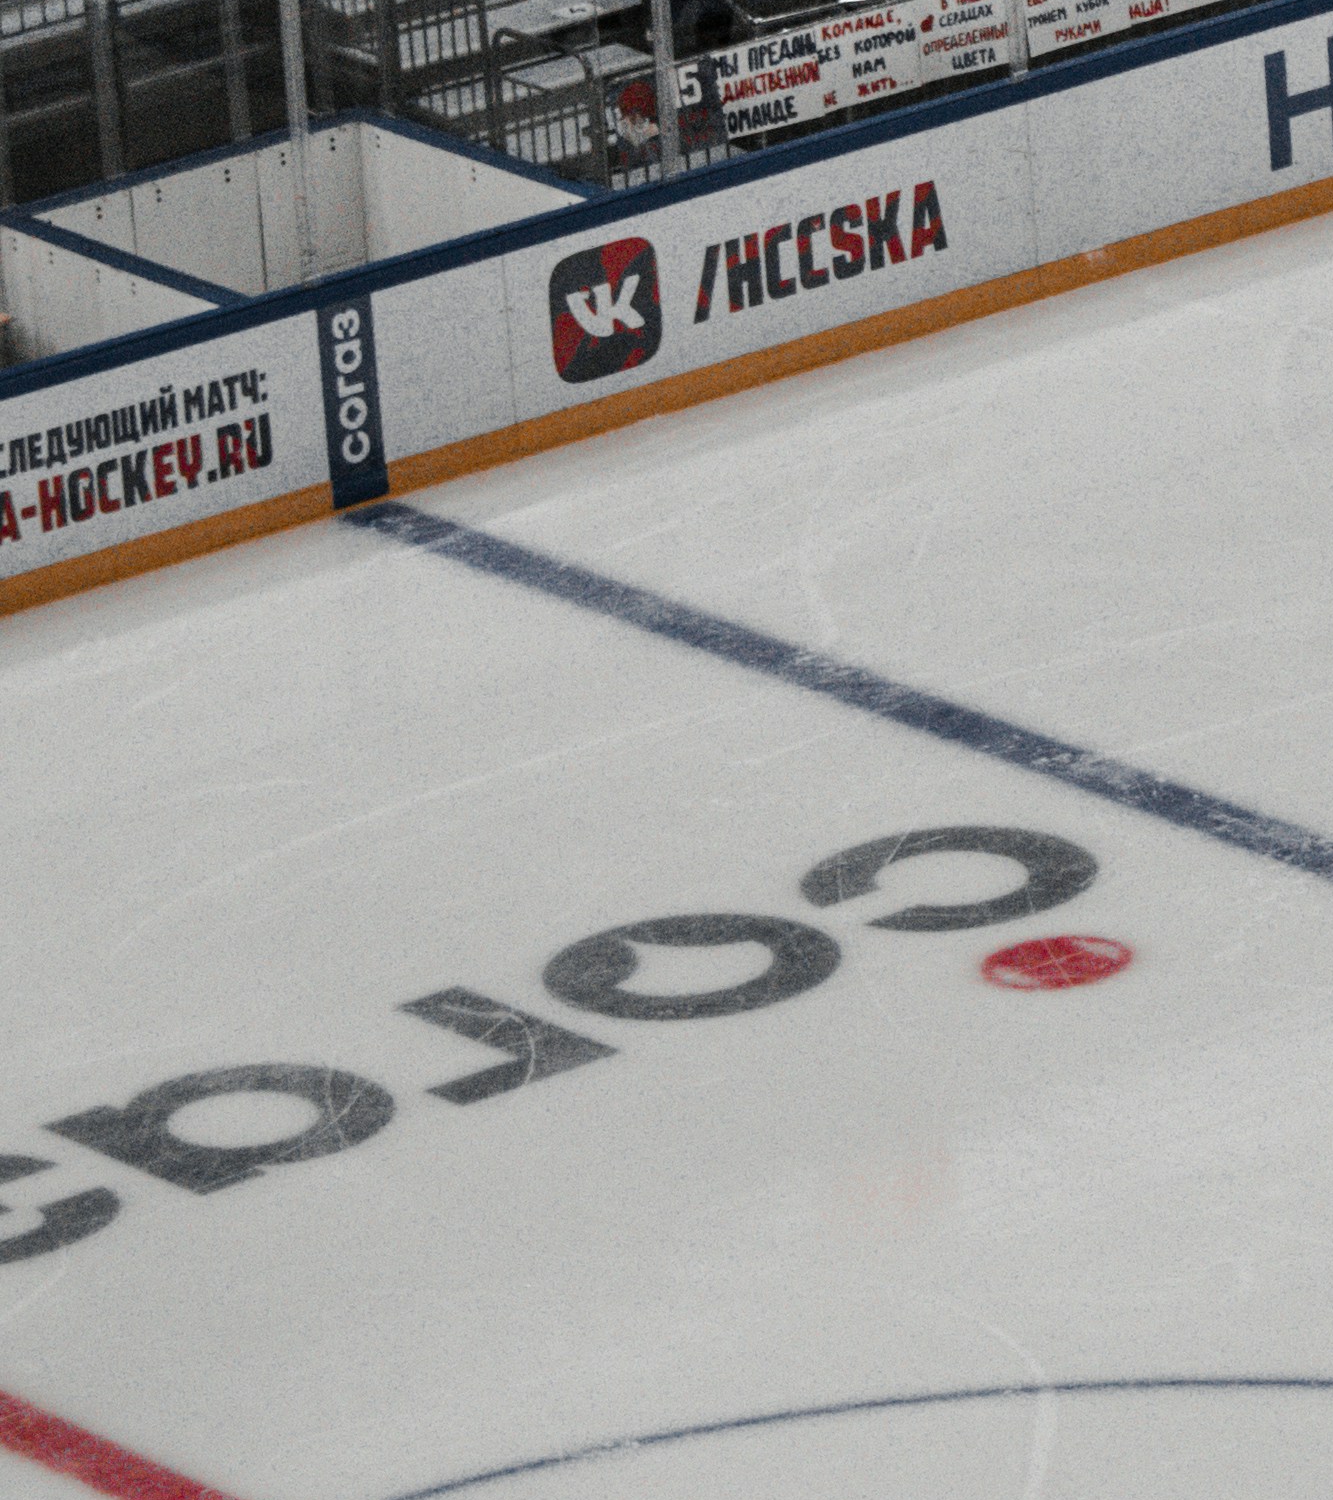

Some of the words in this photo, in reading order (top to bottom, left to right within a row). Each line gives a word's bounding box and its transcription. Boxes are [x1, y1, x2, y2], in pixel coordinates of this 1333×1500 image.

[938, 3, 993, 28] СЕРДЦАХ
[1055, 19, 1101, 43] РУКАМИ
[817, 45, 841, 66] БЕЗ
[854, 22, 916, 54] КОТОРОЙ
[923, 22, 1009, 56] ОПРЕДЕЛЕННЫ
[852, 57, 886, 78] НАМ
[951, 48, 996, 71] ЦВЕТА
[721, 56, 820, 104] ДИНСТВЕННОЙ
[727, 94, 798, 134] ОМАНДЕ
[694, 180, 949, 325] /HCCSKA
[183, 369, 268, 424] МАТЧ:
